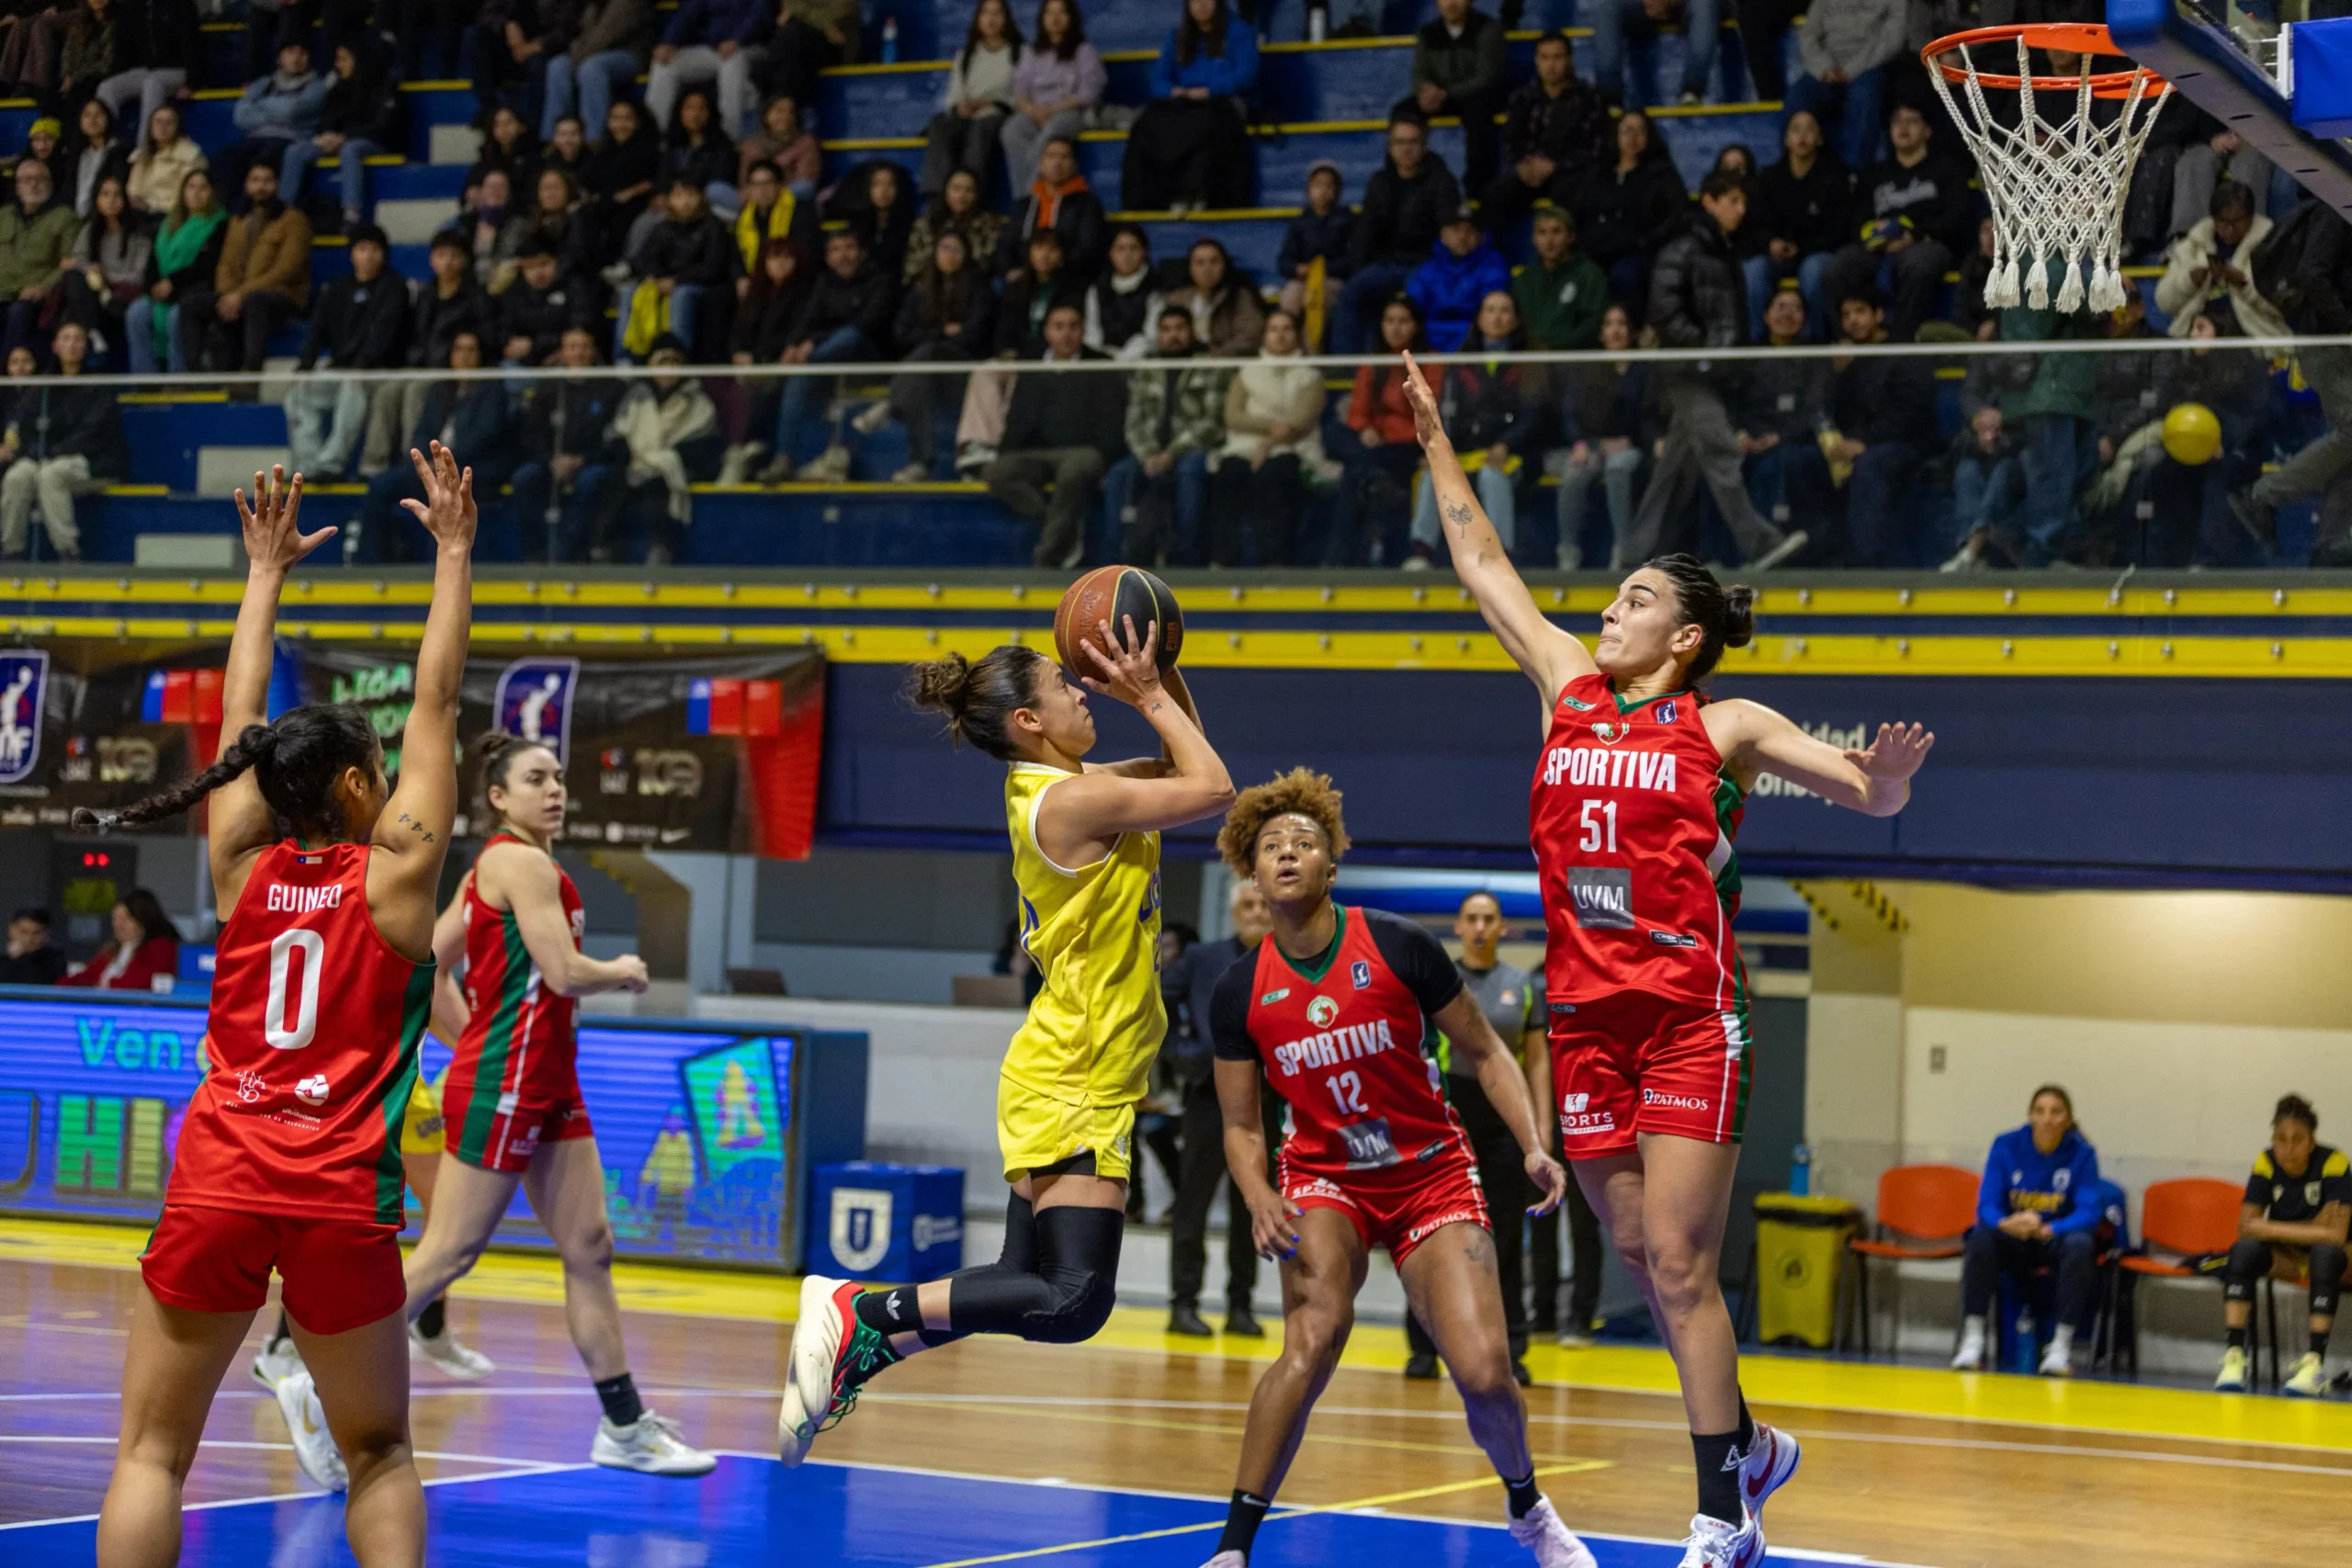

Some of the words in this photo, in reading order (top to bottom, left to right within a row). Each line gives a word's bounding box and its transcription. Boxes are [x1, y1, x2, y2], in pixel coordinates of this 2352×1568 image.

[1544, 748, 1676, 793] SPORTIVA
[1579, 799, 1617, 853] 51
[267, 884, 343, 913] GUINEO
[1573, 885, 1624, 911] UVM
[265, 928, 324, 1050] 0
[76, 1016, 182, 1071] Ven
[1274, 1019, 1396, 1077] SPORTIVA
[1326, 1070, 1369, 1115] 12
[1654, 1092, 1709, 1111] PATMOS
[1347, 1130, 1390, 1158] UVM
[1422, 1210, 1473, 1236] PATMOS
